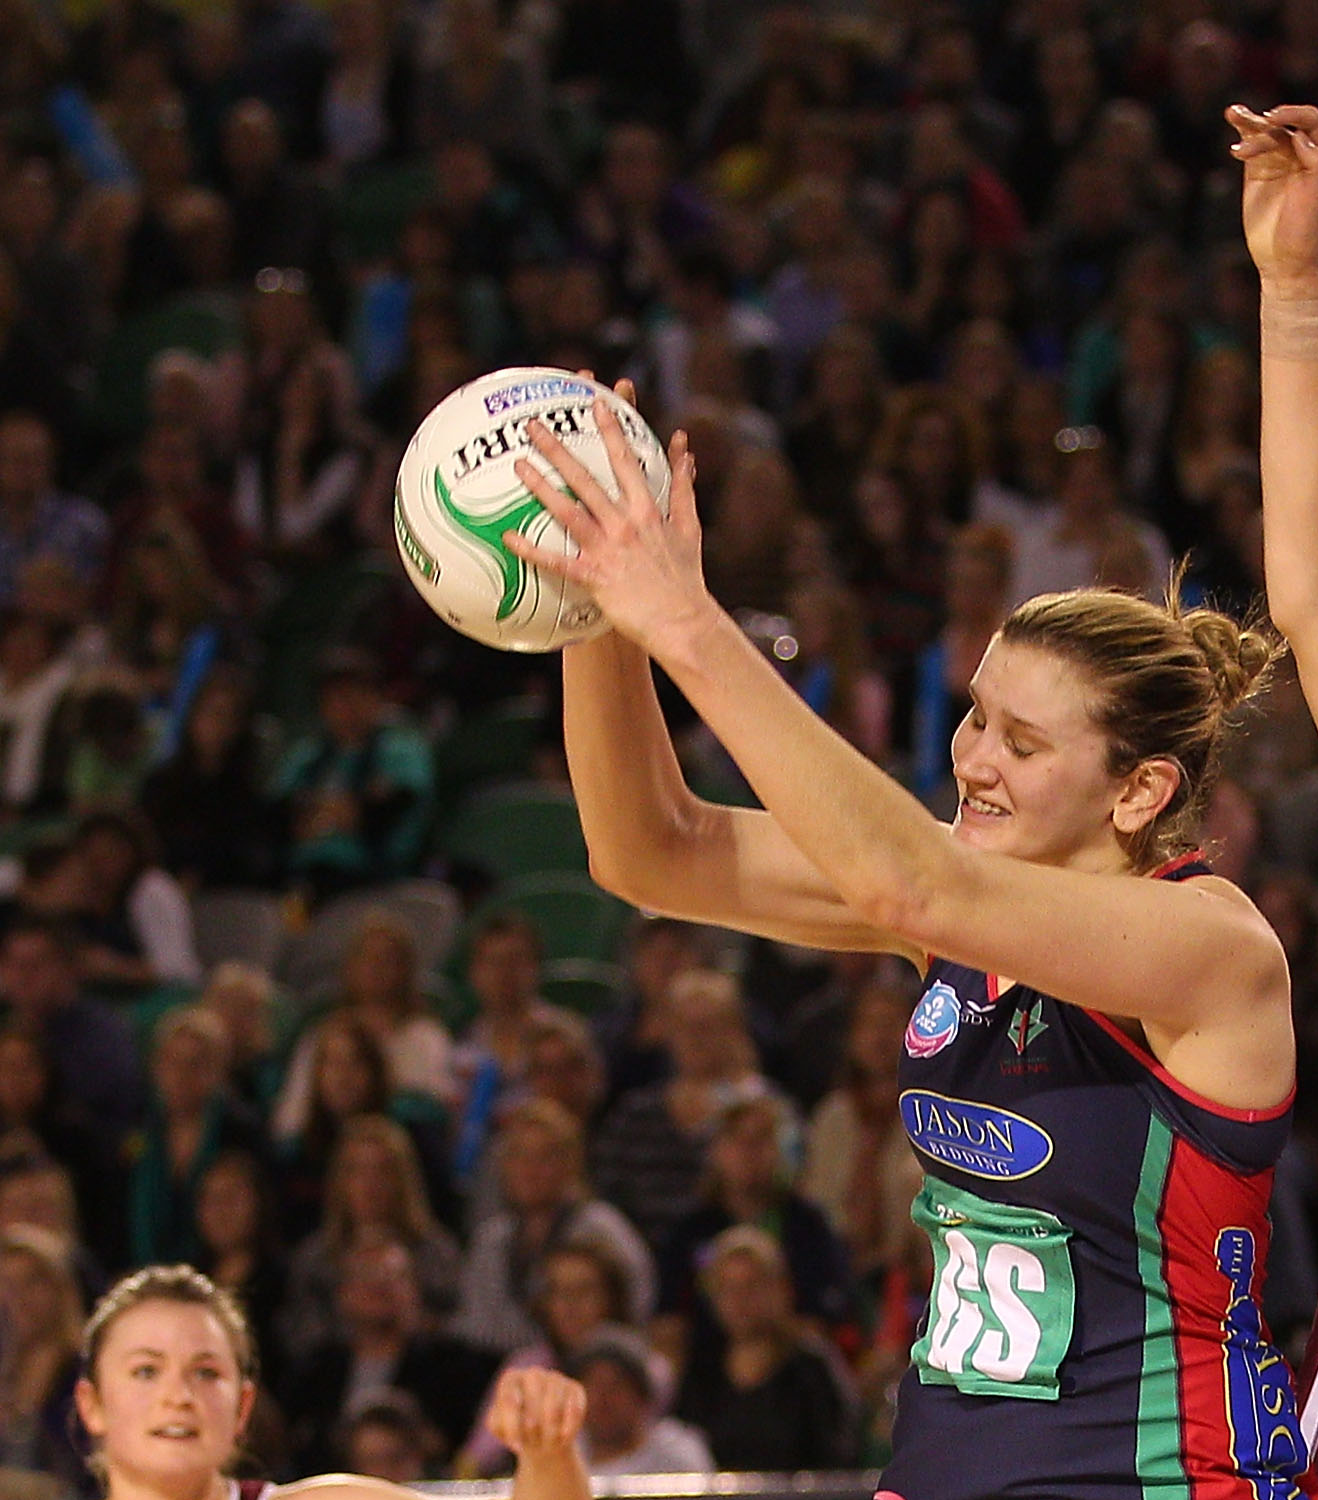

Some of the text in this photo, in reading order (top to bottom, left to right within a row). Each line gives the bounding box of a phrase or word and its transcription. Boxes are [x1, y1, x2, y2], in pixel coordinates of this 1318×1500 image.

[907, 1099, 1016, 1153] JASON
[927, 1140, 1012, 1176] BEDDING
[926, 1229, 1046, 1383] GS
